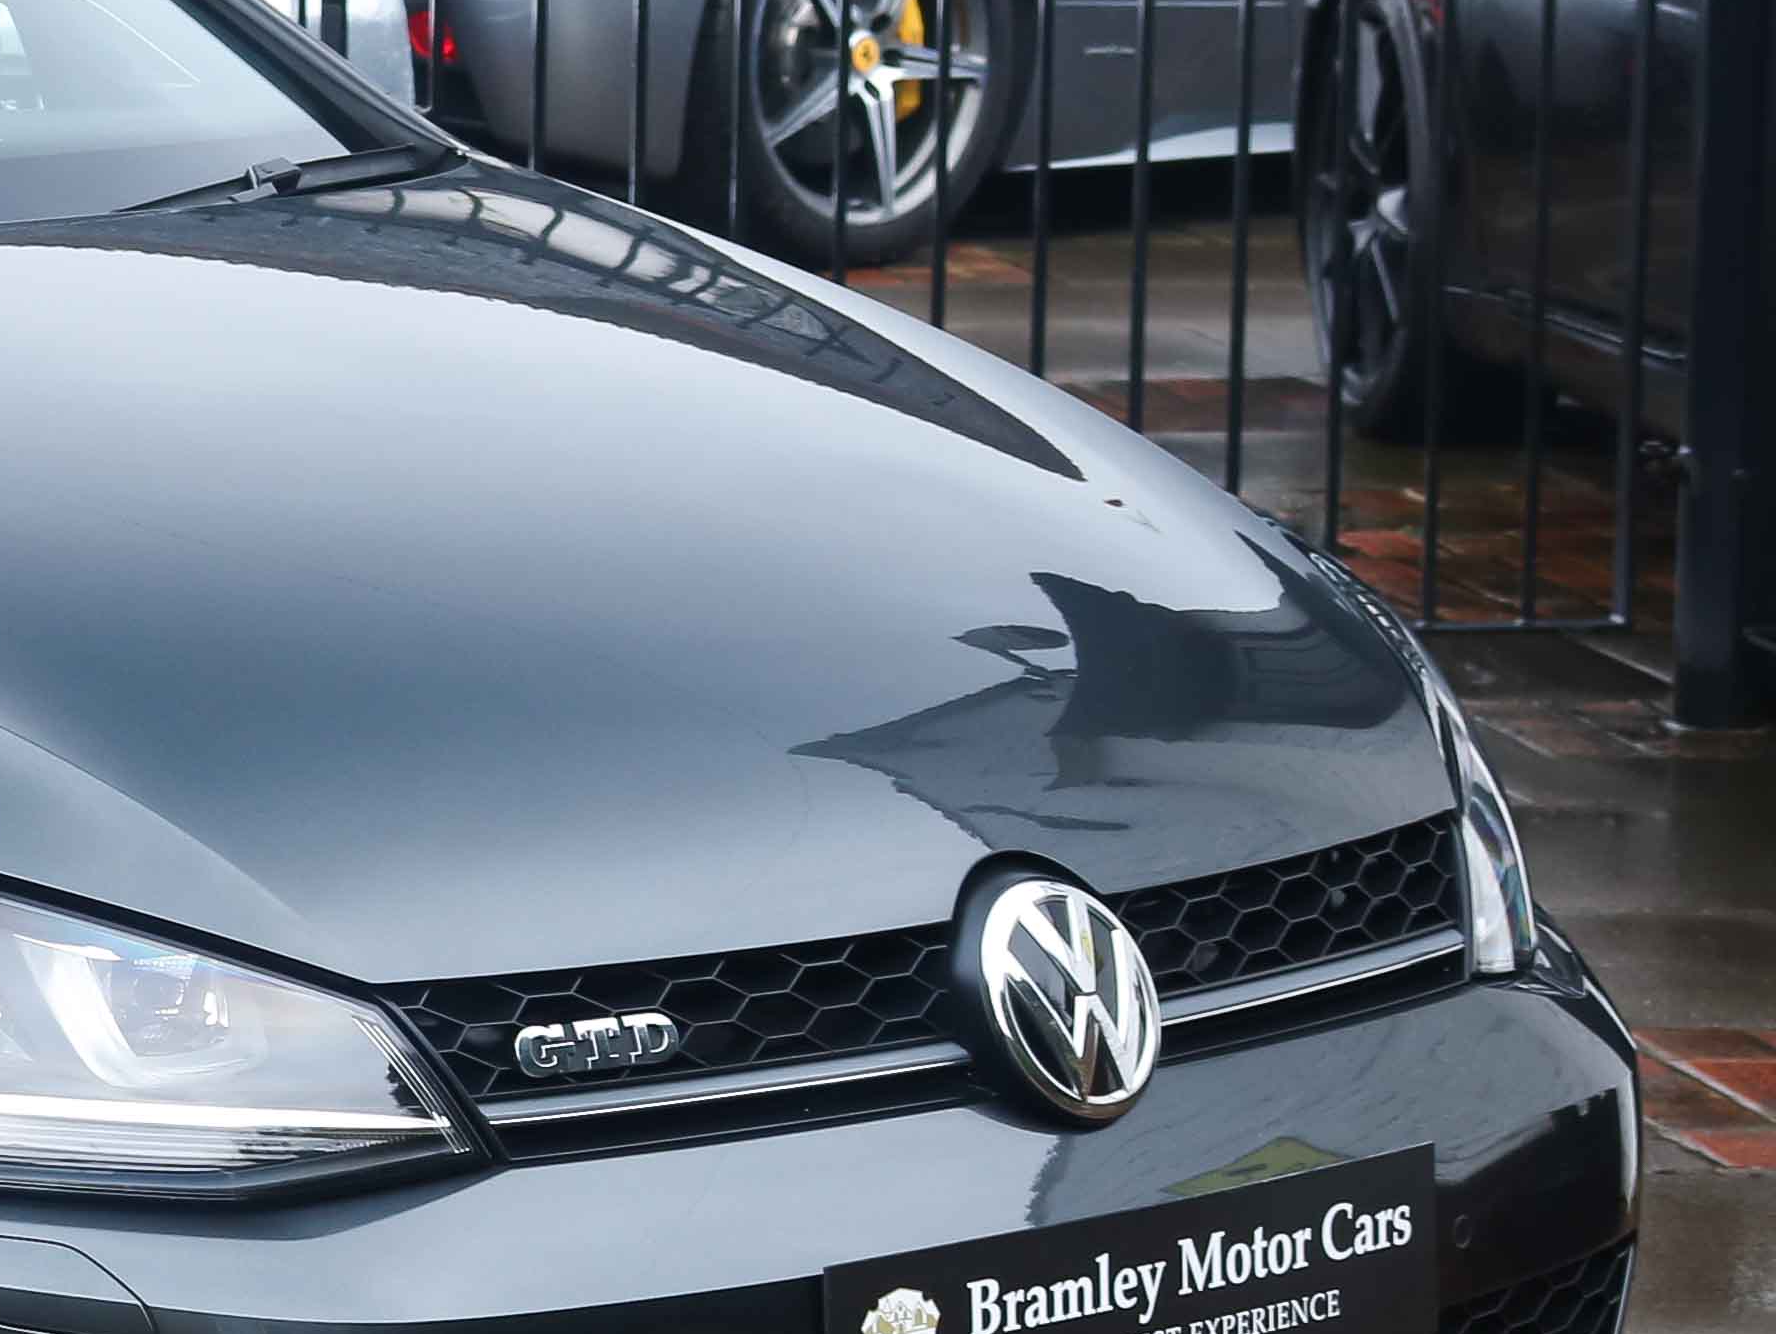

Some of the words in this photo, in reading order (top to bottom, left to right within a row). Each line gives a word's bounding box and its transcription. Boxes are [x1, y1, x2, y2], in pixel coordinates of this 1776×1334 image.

[514, 1011, 680, 1078] GTD
[1176, 1225, 1313, 1296] Motor
[1321, 1201, 1414, 1262] Cars
